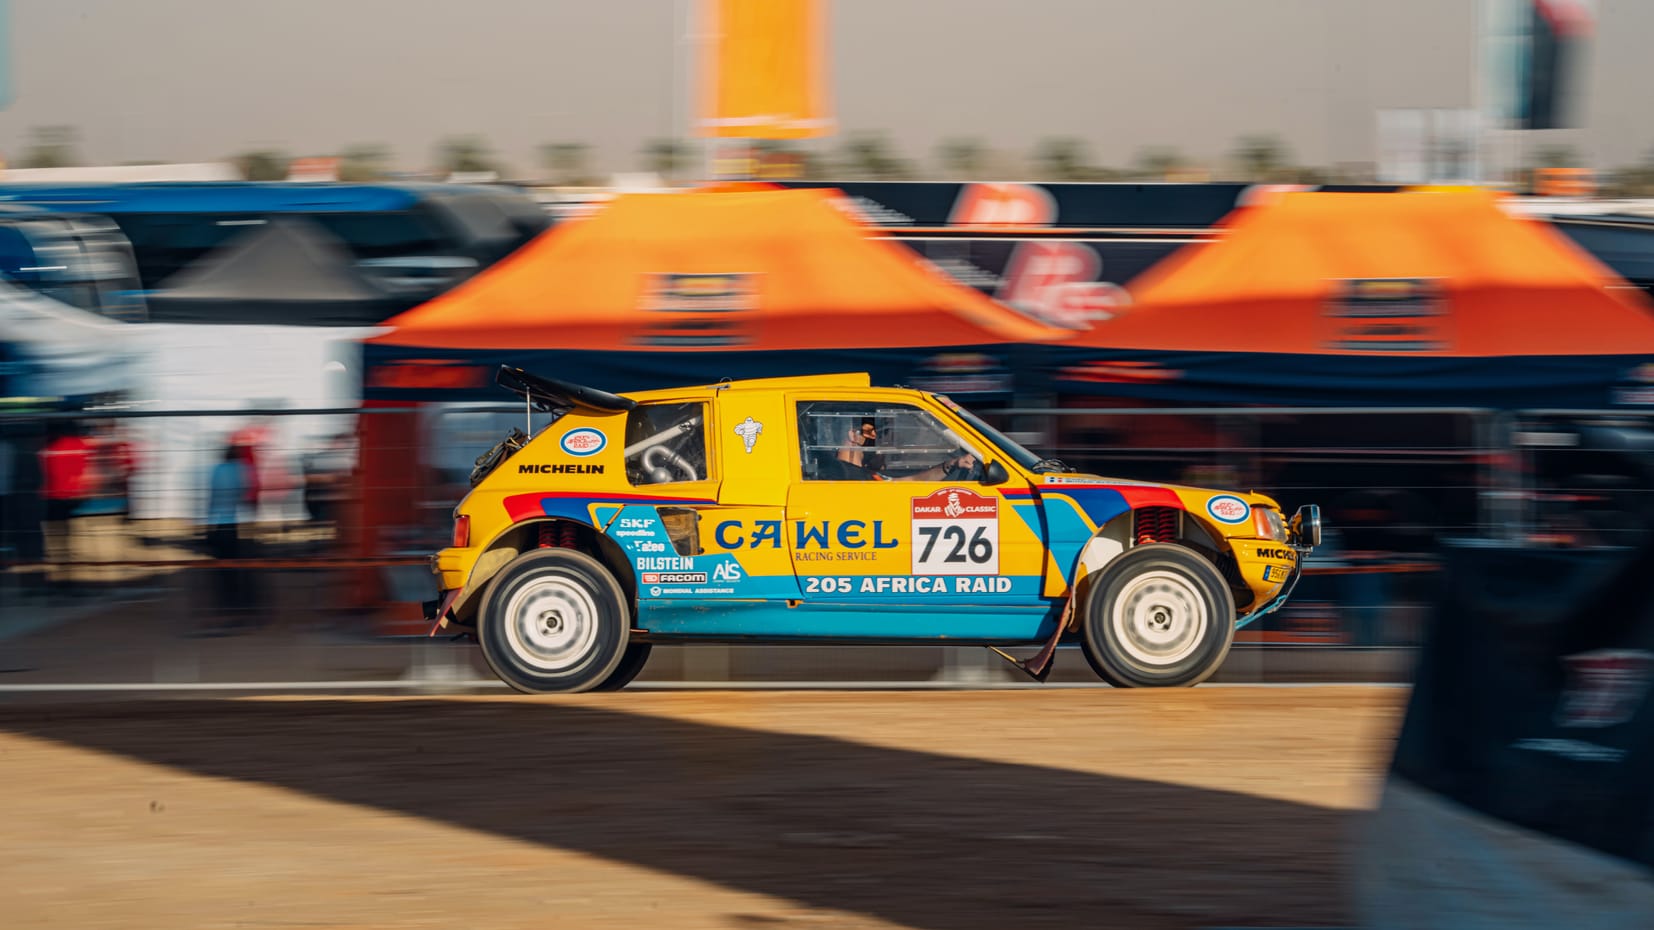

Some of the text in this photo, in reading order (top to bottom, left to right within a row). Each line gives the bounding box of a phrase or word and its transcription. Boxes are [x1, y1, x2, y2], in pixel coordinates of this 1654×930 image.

[518, 464, 604, 474] MICHELIN
[620, 518, 655, 528] SKF
[918, 525, 993, 564] 726
[795, 551, 877, 561] RACING SERVICE
[637, 557, 694, 570] BILSTEIN
[660, 574, 705, 582] FACOM
[806, 577, 1012, 593] 205 AFRICA RAID
